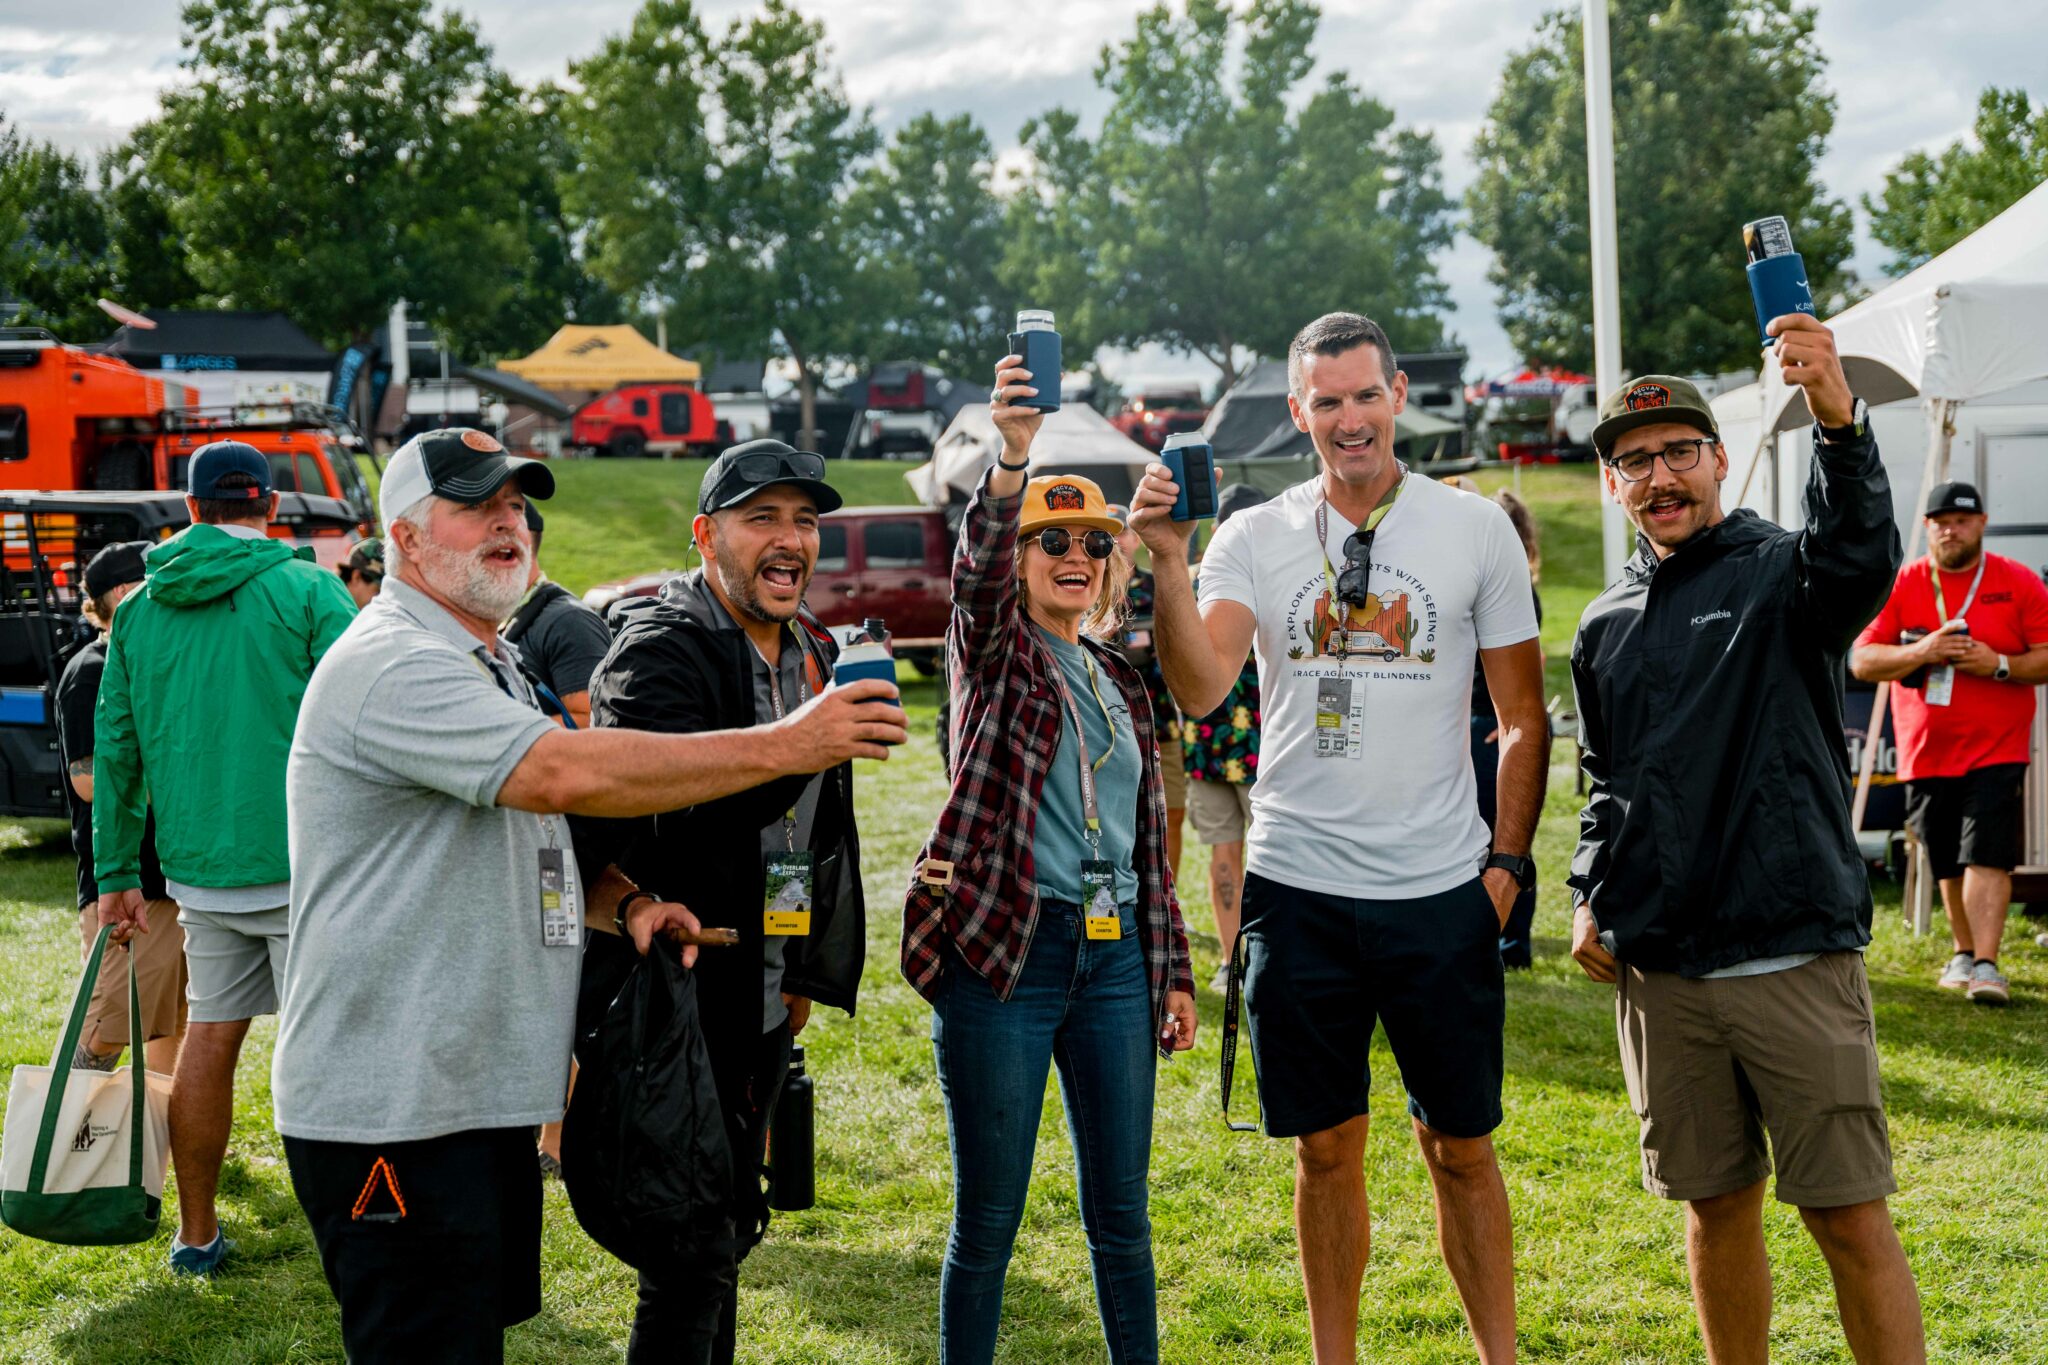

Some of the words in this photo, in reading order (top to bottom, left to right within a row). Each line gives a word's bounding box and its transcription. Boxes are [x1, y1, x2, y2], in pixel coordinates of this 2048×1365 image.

[1633, 386, 1660, 397] RECVAN
[1052, 485, 1077, 493] RECVAN
[1287, 571, 1326, 640] EXPLORATIO
[1396, 568, 1426, 593] WITH
[1422, 594, 1437, 643] SEEING
[1694, 610, 1731, 624] Columbia
[1373, 672, 1431, 681] BLINDNESS
[1083, 773, 1093, 809] HONDA
